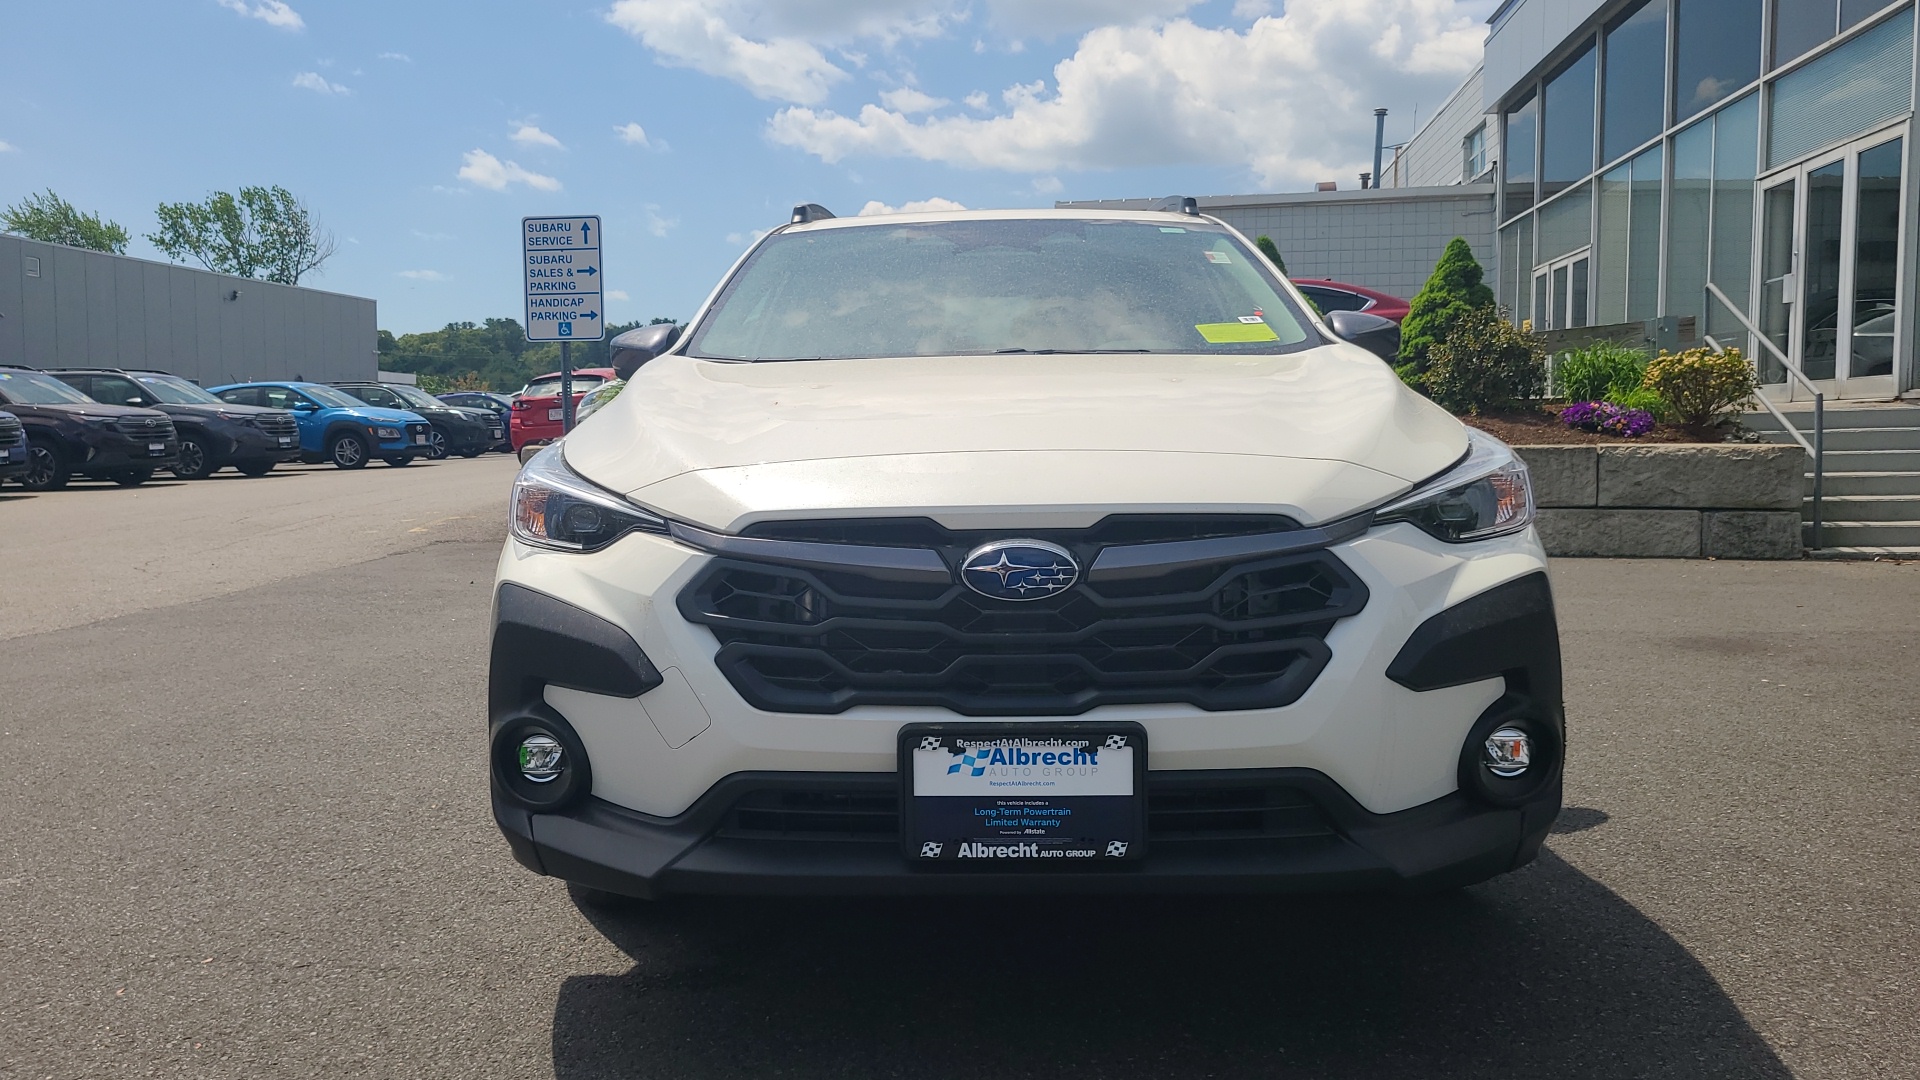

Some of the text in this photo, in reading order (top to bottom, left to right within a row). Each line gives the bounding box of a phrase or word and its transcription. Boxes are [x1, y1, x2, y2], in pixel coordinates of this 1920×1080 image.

[528, 223, 571, 232] SUBARU
[528, 236, 573, 246] SERVICE
[529, 255, 573, 264] SUBARU
[530, 268, 574, 278] SALES &
[530, 281, 576, 291] PARKING
[530, 298, 584, 307] HANDICAP
[531, 311, 577, 321] PARKING
[956, 738, 1089, 749] RespectAtAlbrecht.com
[989, 748, 1098, 766] Albrecht
[989, 767, 1099, 776] AUTO GROUP
[974, 808, 1072, 818] Long-Term Powertrain
[985, 818, 1061, 828] Limited Warranty
[957, 842, 1096, 858] Albrecht AUTO GROUP
